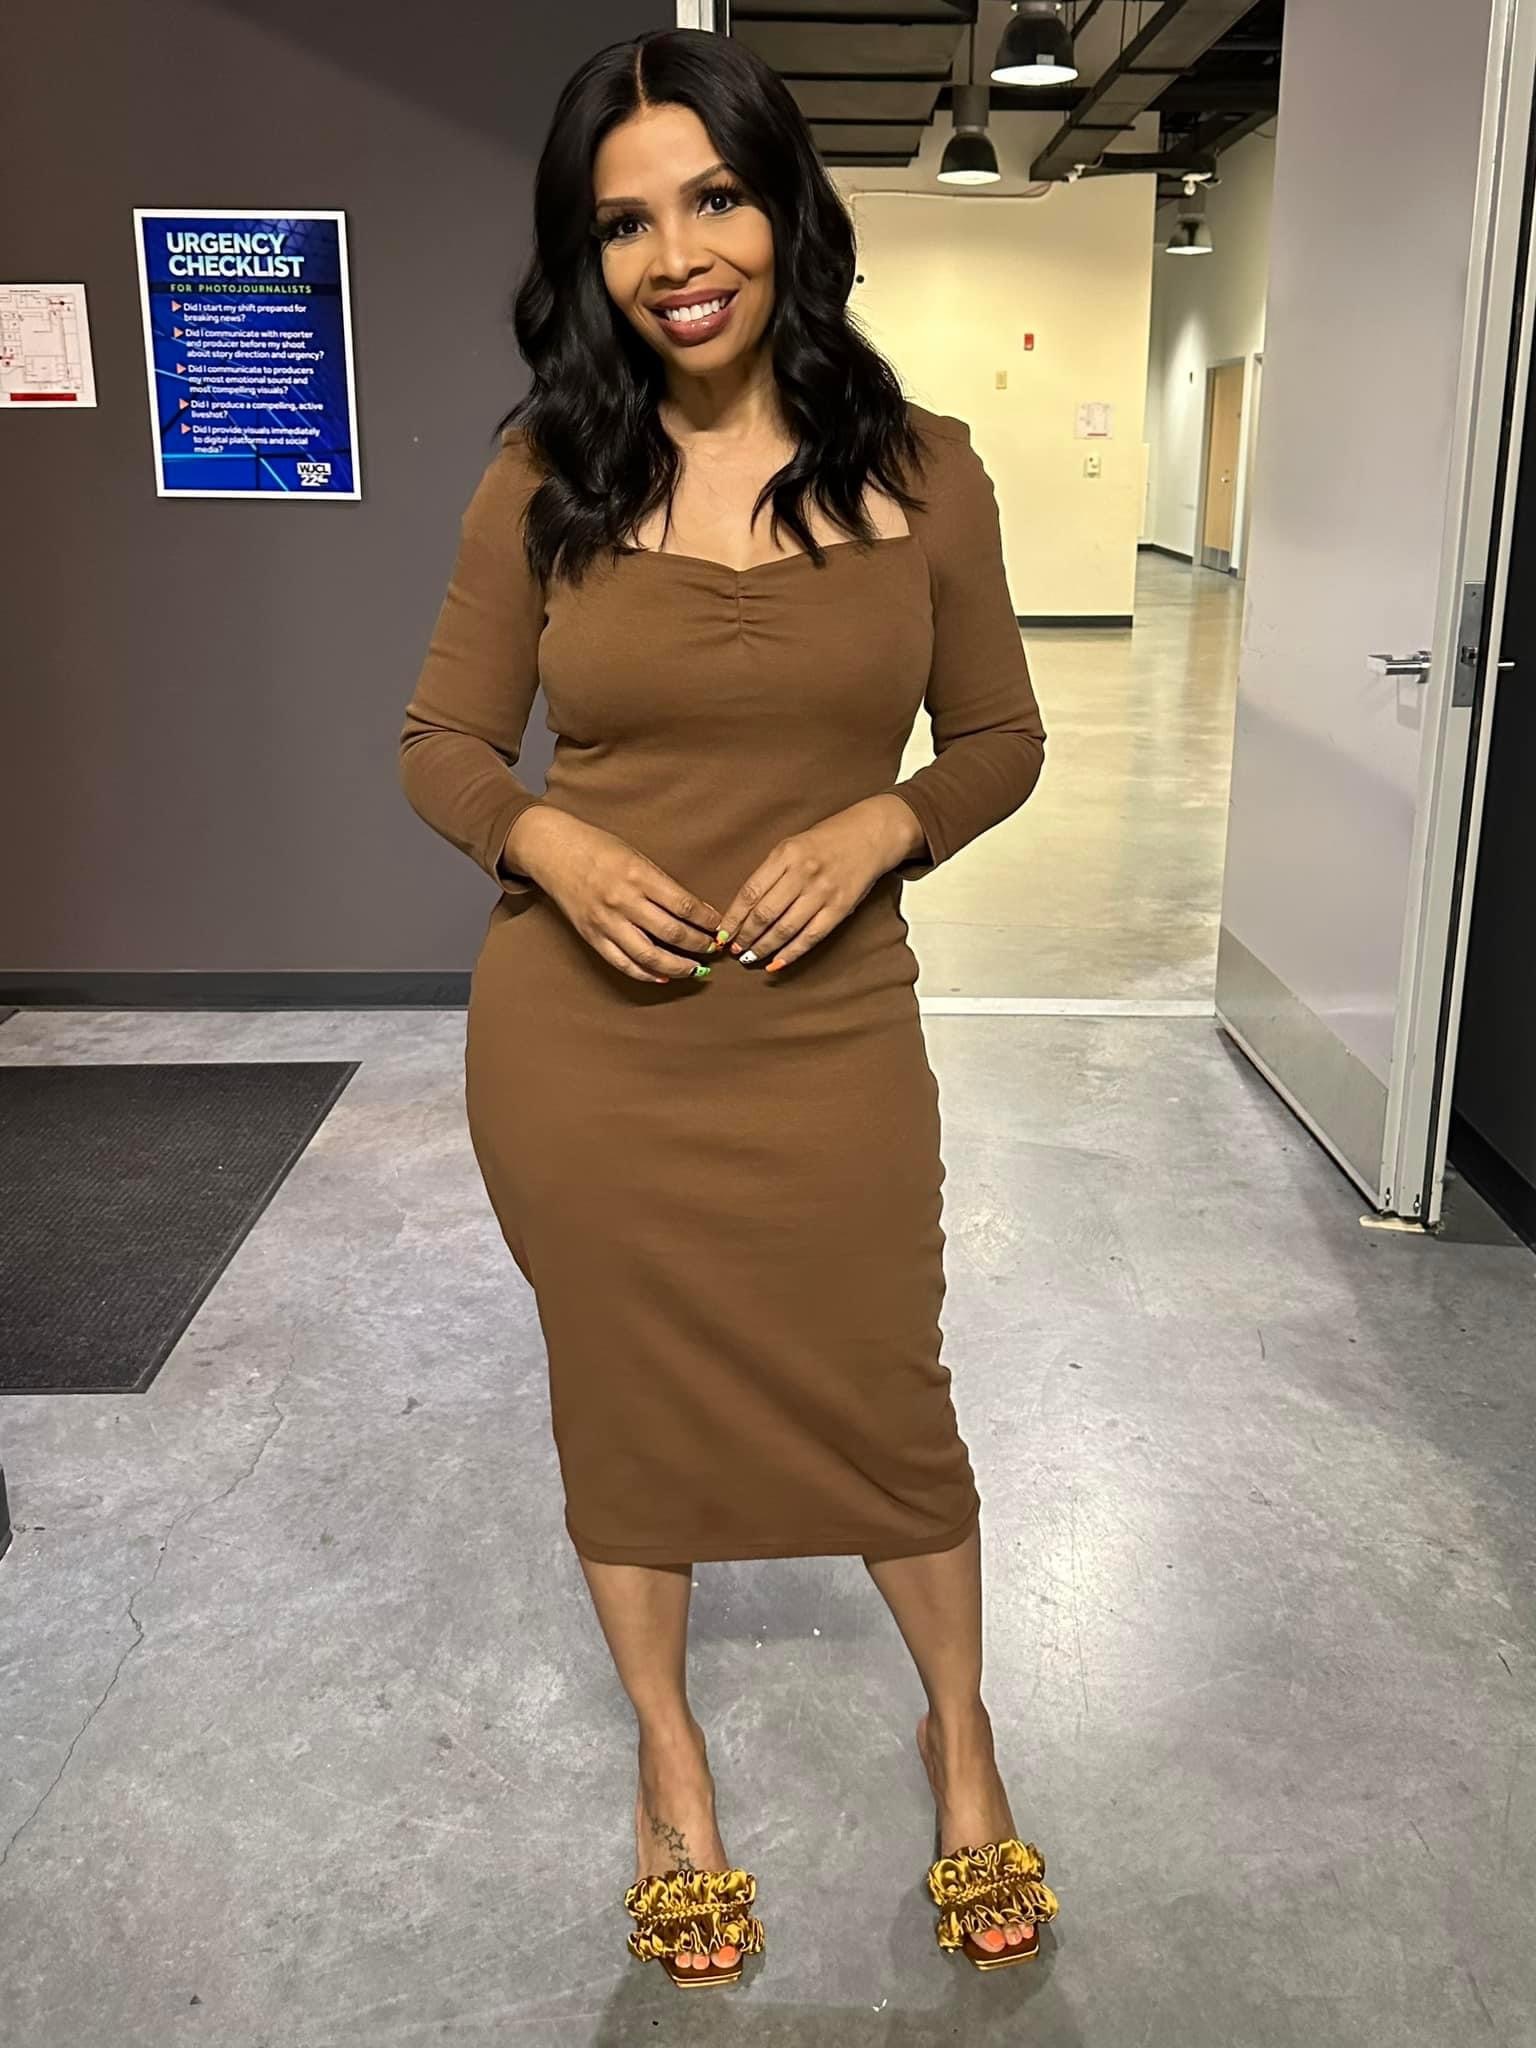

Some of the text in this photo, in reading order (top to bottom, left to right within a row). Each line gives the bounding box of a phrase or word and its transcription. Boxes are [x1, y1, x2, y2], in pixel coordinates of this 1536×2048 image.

[166, 231, 285, 254] URGENCY
[168, 255, 305, 277] CHECKLIST
[170, 284, 312, 294] FOR PHOTOJOURNALISTS
[183, 303, 198, 311] Did
[203, 304, 222, 312] start
[223, 305, 236, 314] my
[238, 304, 256, 312] shift
[257, 304, 294, 314] prepared
[294, 304, 307, 312] for
[183, 313, 246, 324] breaking news?
[185, 328, 200, 337] Did
[204, 330, 259, 338] communicate
[260, 330, 279, 338] with
[280, 331, 313, 339] reporter
[203, 340, 239, 348] producer
[240, 340, 267, 348] before
[268, 341, 280, 350] my
[282, 341, 306, 349] shoot
[187, 350, 325, 361] about story direction and urgency?
[188, 364, 203, 373] Did
[207, 366, 262, 374] communicate
[263, 366, 273, 374] to
[273, 366, 314, 375] producers
[188, 376, 202, 385] my
[225, 375, 266, 384] emotional
[267, 376, 292, 384] sound
[293, 376, 309, 385] and
[190, 385, 289, 395] most compelling visuals?
[191, 399, 206, 408] Did
[211, 401, 245, 410] produce
[252, 401, 298, 412] compelling,
[299, 402, 324, 410] active
[192, 410, 228, 419] liveshot?
[192, 425, 207, 433] Did
[212, 425, 242, 435] provide
[243, 425, 270, 434] visuals
[271, 426, 320, 437] immediately
[204, 436, 228, 445] digital
[229, 436, 268, 445] platforms
[269, 437, 284, 445] and
[285, 437, 308, 445] social
[194, 445, 224, 453] media?
[299, 464, 329, 473] WJCL
[301, 474, 320, 486] 22
